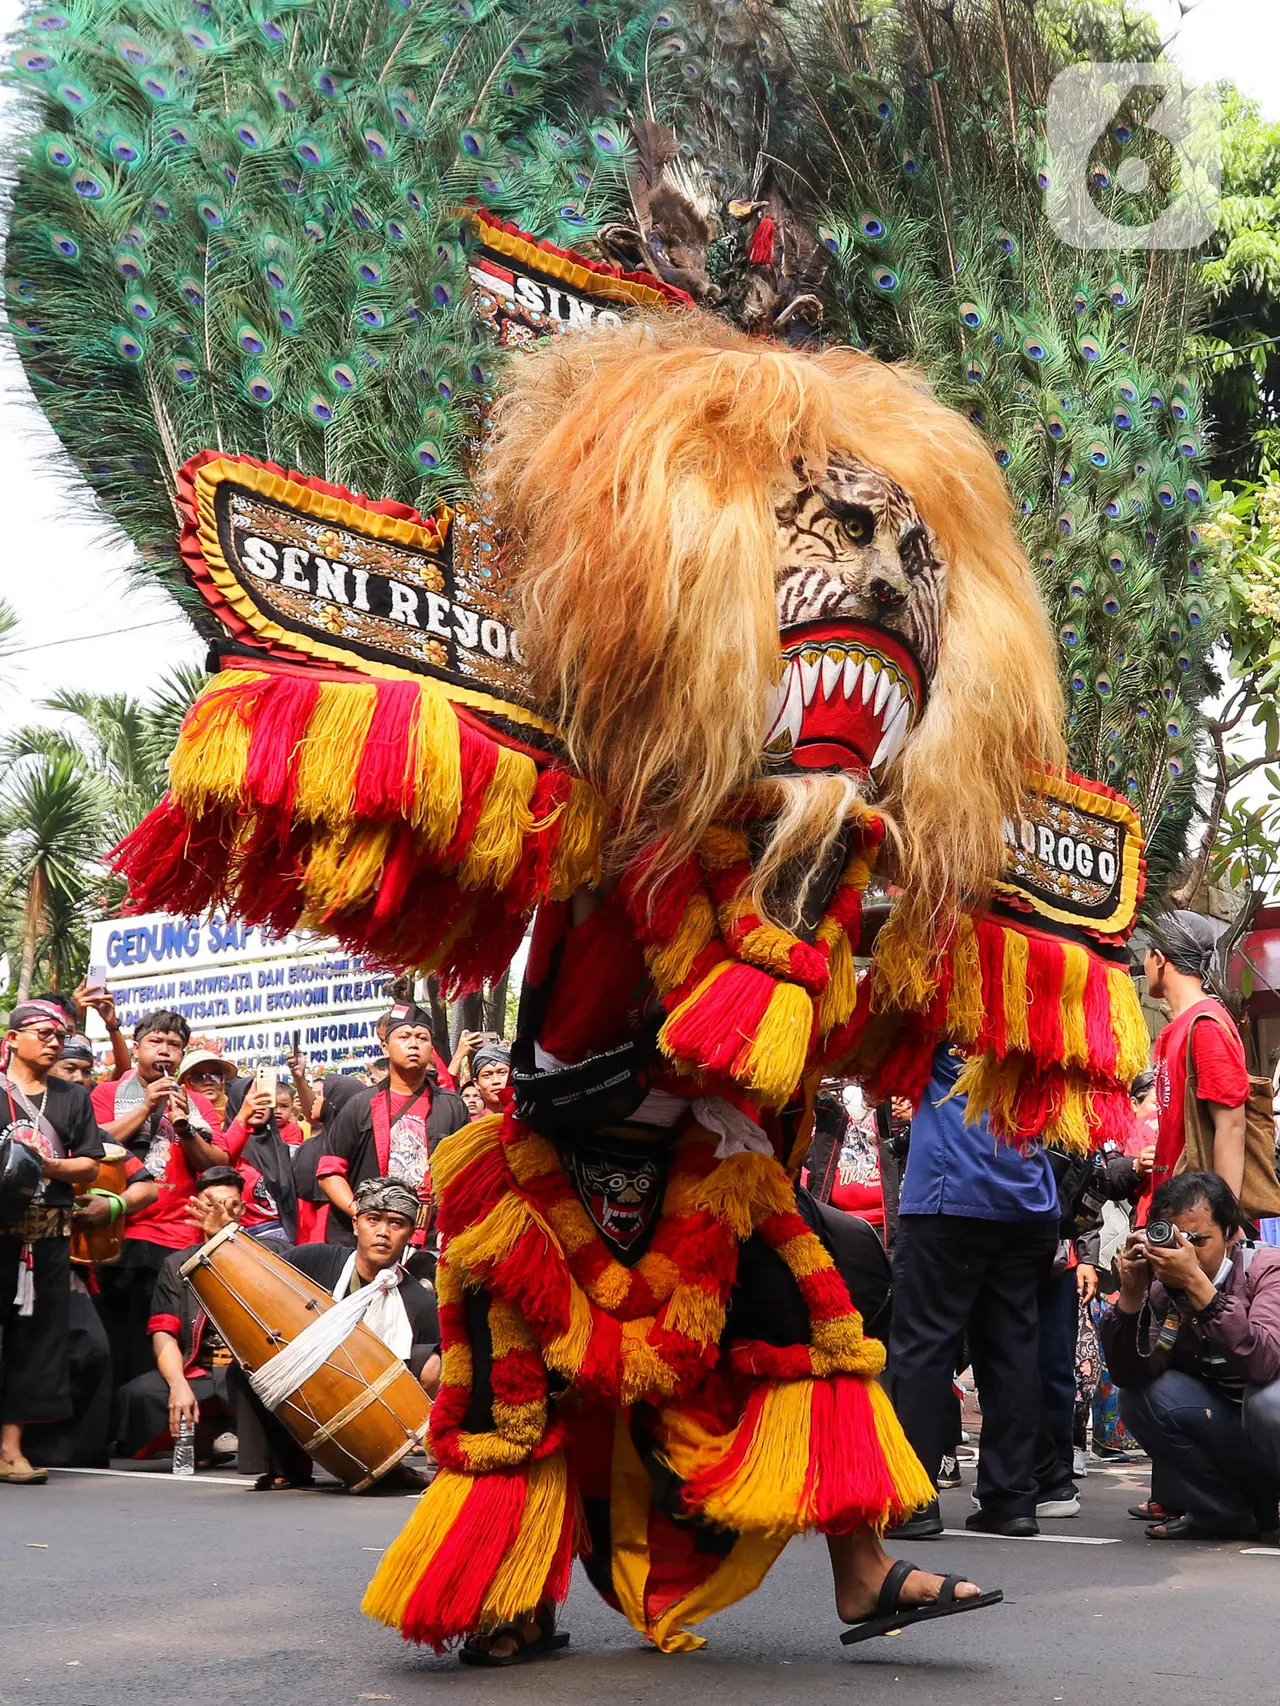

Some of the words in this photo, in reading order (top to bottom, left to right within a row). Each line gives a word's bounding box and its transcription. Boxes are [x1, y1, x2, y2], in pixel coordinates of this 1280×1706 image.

[241, 535, 371, 612] SENI
[107, 917, 200, 967] GEDUNG
[179, 972, 253, 998] PARIWISATA
[258, 967, 285, 988] DAN
[288, 958, 349, 985] EKONOMI
[235, 995, 262, 1015] DAN
[266, 985, 329, 1011] EKONOMI
[310, 1048, 328, 1063] POS
